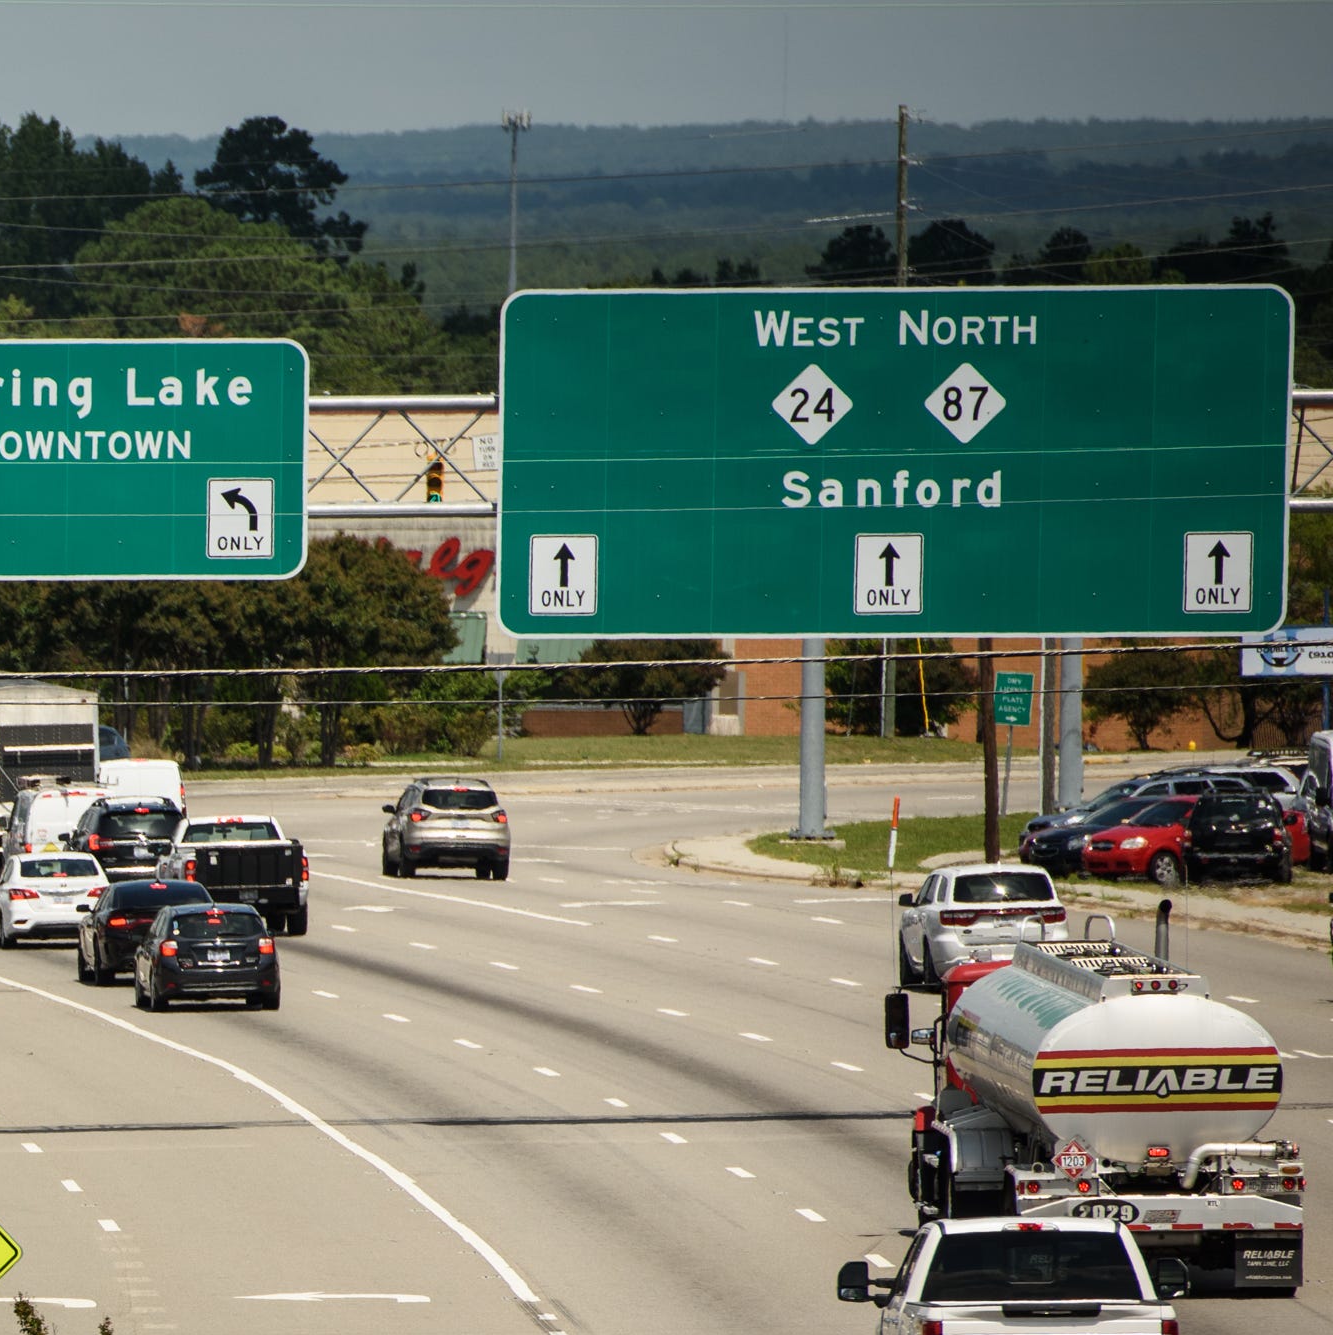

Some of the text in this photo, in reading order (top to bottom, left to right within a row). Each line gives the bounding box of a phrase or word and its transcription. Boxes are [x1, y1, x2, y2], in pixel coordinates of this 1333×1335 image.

[754, 310, 1037, 346] WEST NORTH
[127, 367, 253, 406] Lake
[790, 387, 834, 422] 24
[943, 386, 989, 421] 87
[782, 470, 1001, 508] Sanford
[218, 536, 263, 551] ONLY
[542, 589, 585, 608] ONLY
[866, 588, 911, 607] ONLY
[1195, 587, 1240, 606] ONLY
[1039, 1067, 1277, 1095] RELIABLE
[1062, 1156, 1085, 1166] 1203
[1078, 1204, 1134, 1221] 2029
[1243, 1250, 1295, 1259] RELIABLE
